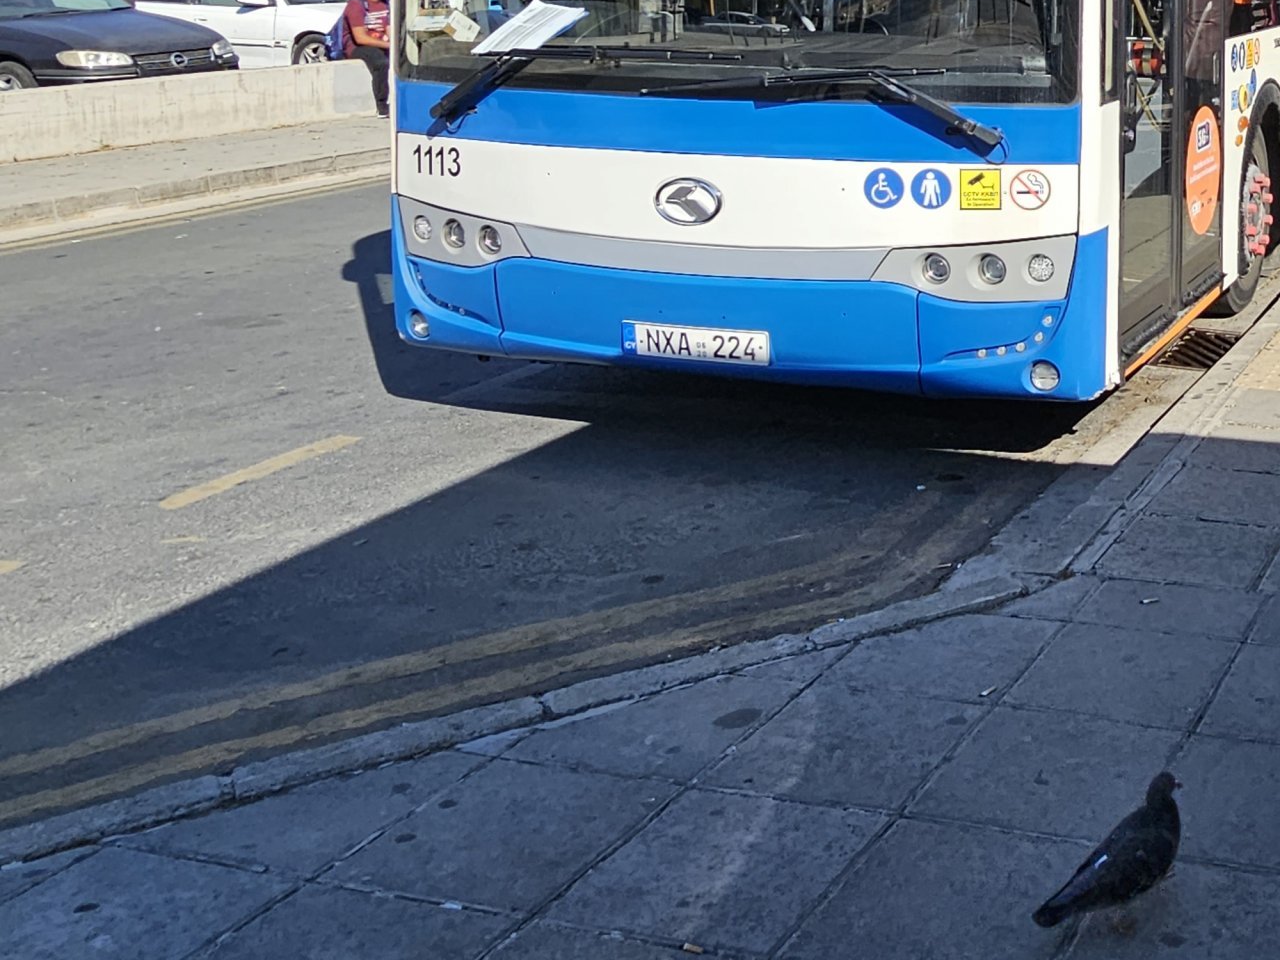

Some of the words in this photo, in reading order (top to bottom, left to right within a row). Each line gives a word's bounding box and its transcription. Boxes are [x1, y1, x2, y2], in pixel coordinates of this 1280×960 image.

[413, 144, 461, 177] 1113
[624, 341, 636, 349] CY
[646, 328, 692, 356] NXA
[712, 335, 755, 361] 224
